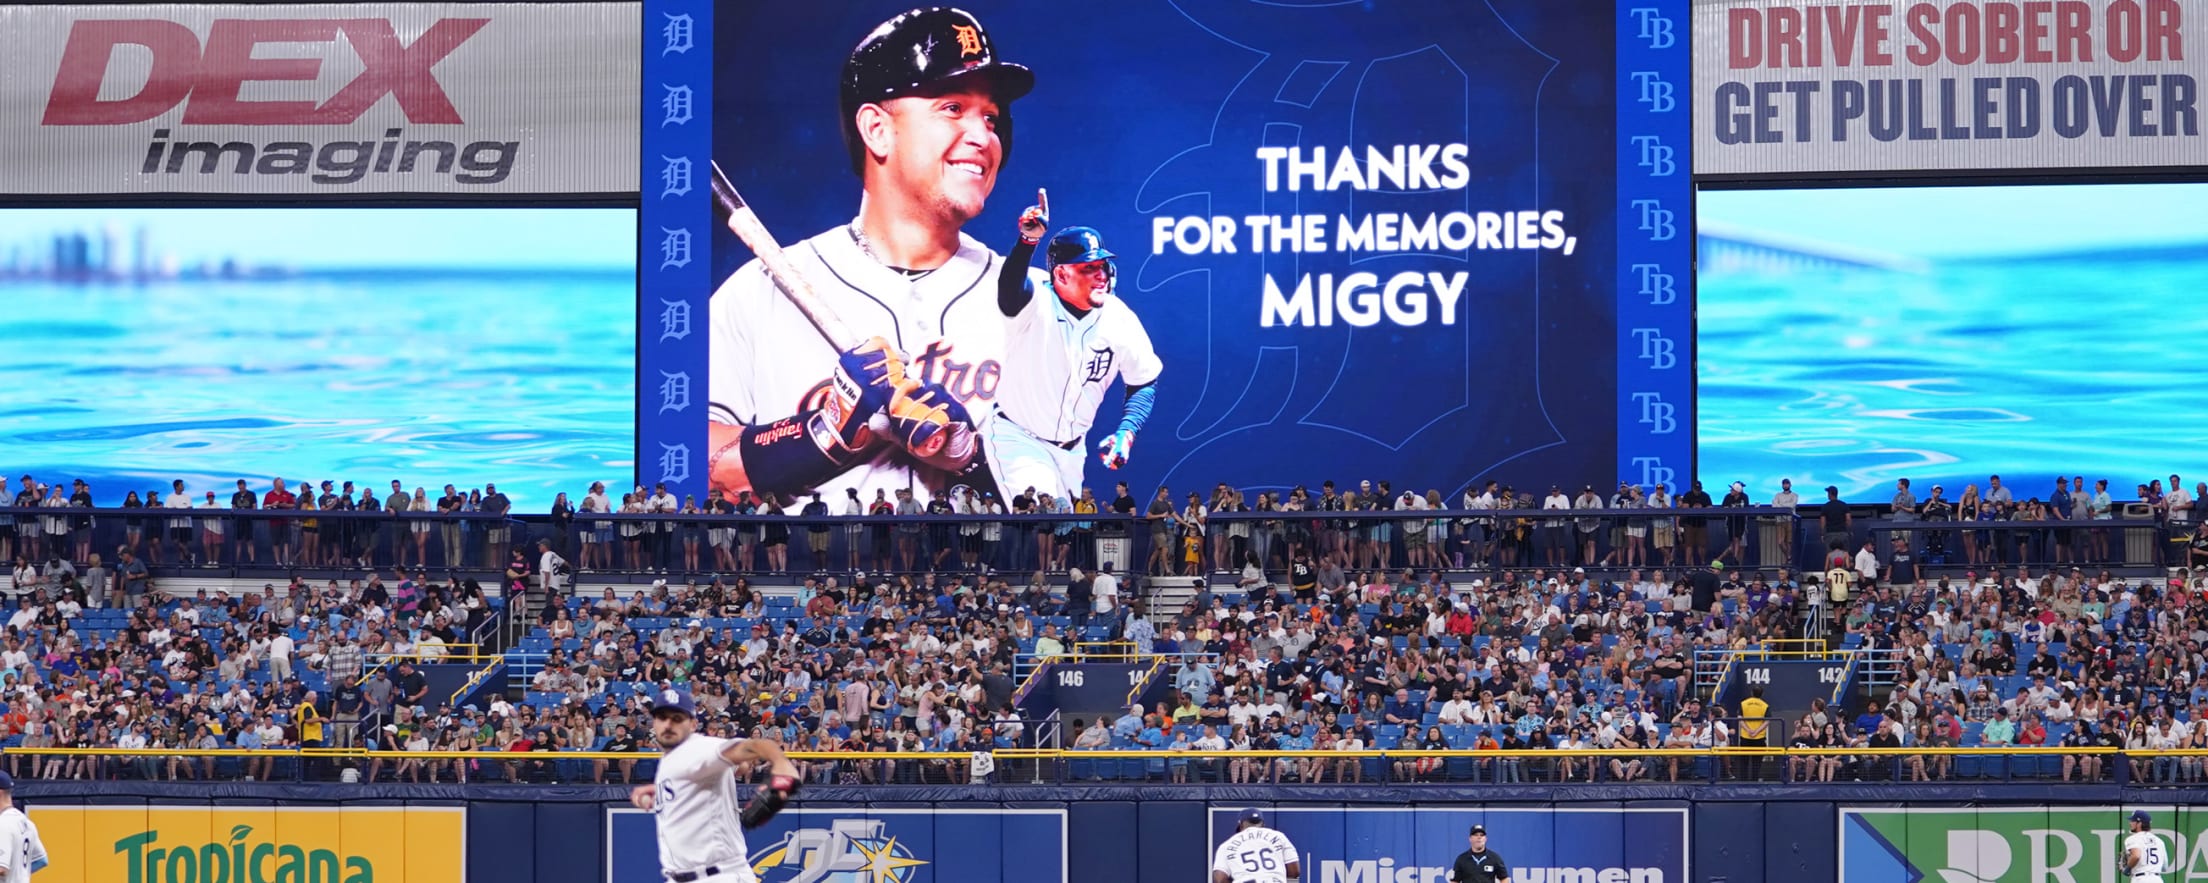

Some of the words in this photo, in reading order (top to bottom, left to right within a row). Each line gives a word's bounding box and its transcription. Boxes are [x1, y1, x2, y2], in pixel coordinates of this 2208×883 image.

[1630, 8, 1675, 49] TB
[1728, 4, 1893, 69] DRIVE
[1906, 1, 2093, 66] SOBER
[2105, 0, 2184, 63] OR
[41, 18, 492, 125] DEX
[1631, 71, 1675, 112] TB
[1715, 81, 1820, 145] GET
[1832, 76, 2042, 142] PULLED
[2053, 73, 2199, 139] OVER
[141, 128, 520, 185] imaging
[1256, 143, 1470, 192] THANKS
[1631, 135, 1676, 177] TB
[1152, 214, 1237, 255] FOR
[1245, 213, 1327, 253] THE
[1336, 210, 1576, 256] MEMORIES,
[1631, 199, 1676, 241] TB
[1260, 271, 1469, 327] MIGGY
[1632, 263, 1676, 305] TB
[1632, 328, 1676, 369] TB
[1632, 392, 1677, 434] TB
[1057, 670, 1084, 686] 146
[1128, 670, 1151, 685] 14
[1744, 668, 1771, 684] 144
[1241, 847, 1276, 872] 56
[1320, 857, 1664, 883] Micrumen
[2146, 847, 2159, 865] 15
